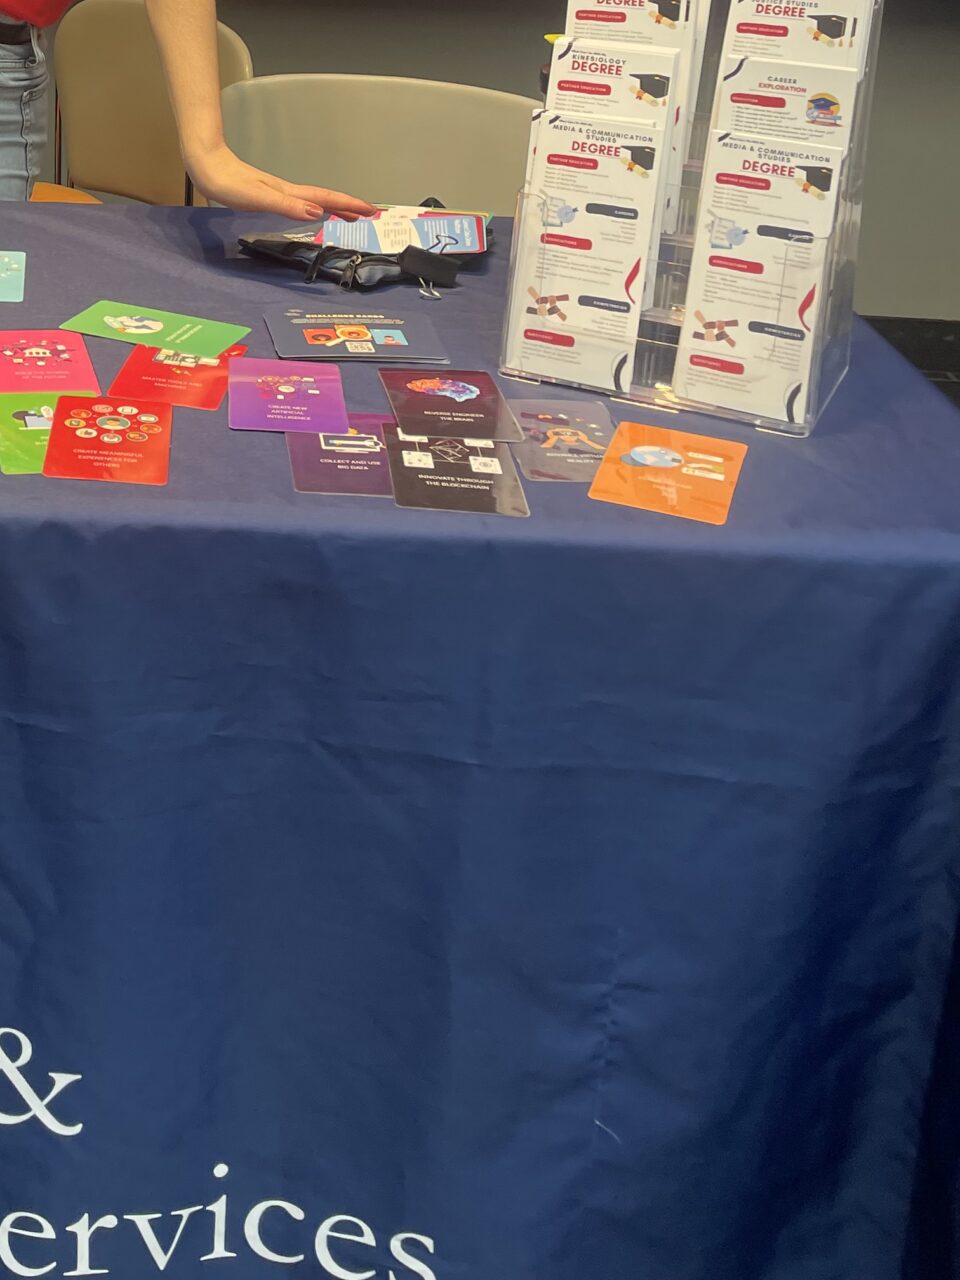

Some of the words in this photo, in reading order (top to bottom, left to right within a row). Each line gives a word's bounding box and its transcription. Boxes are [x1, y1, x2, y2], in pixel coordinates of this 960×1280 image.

[786, 0, 819, 8] STUDIES
[755, 3, 806, 18] DEGREE
[572, 54, 627, 65] KINESIOLOGY
[571, 60, 623, 76] DEGREE
[768, 76, 797, 84] CAREER
[758, 82, 807, 93] EXPLORATION
[552, 124, 576, 132] MEDIA
[586, 128, 653, 143] COMMUNICATION
[586, 134, 617, 143] STUDIES
[572, 140, 620, 157] DEGREE
[722, 142, 747, 150] MEDIA
[757, 147, 831, 163] COMMUNICATION
[758, 153, 791, 163] STUDIES
[742, 160, 795, 177] DEGREE
[78, 454, 122, 462] EXPERIENCES
[99, 450, 143, 458] MEANINGFUL
[441, 482, 490, 490] BLOCKCHAIN
